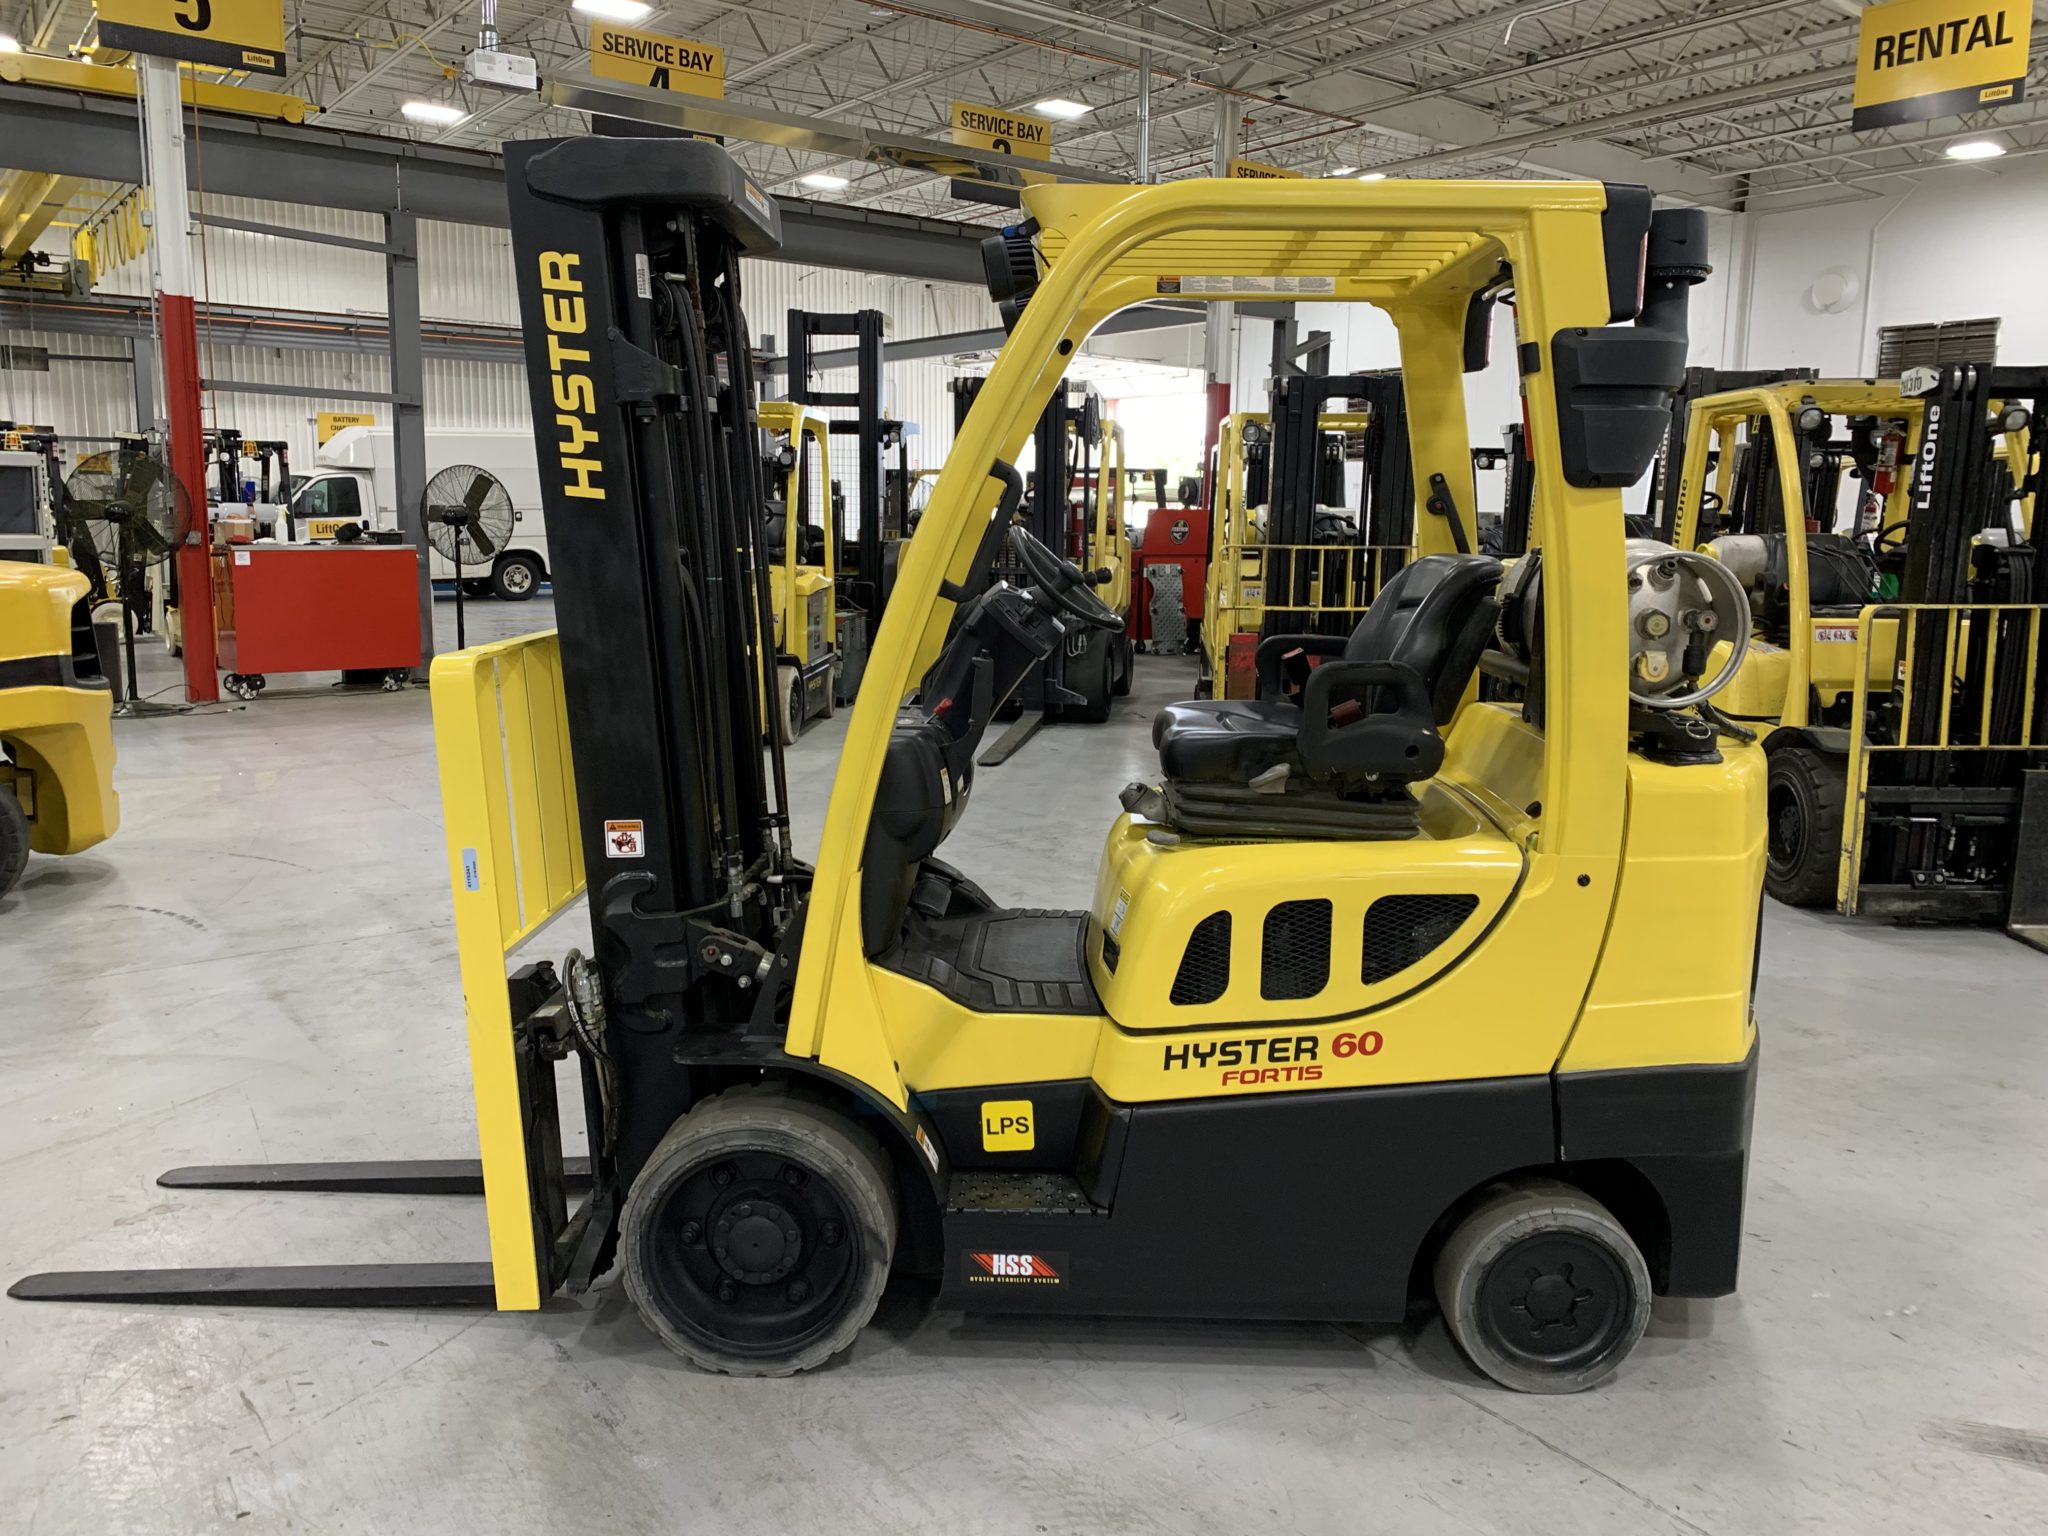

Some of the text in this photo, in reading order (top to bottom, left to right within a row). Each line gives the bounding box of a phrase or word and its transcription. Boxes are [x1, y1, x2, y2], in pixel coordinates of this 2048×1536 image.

[602, 32, 713, 72] SERVICE BAY
[1874, 11, 2014, 71] RENTAL
[247, 54, 271, 65] LiftOne
[1985, 88, 2008, 98] LiftOne
[961, 111, 1043, 142] SERVICE BAY
[539, 251, 606, 500] HYSTER
[1917, 405, 1940, 509] LiftOne
[316, 523, 339, 534] LiftO
[1163, 1031, 1384, 1071] HYSTER 60
[1221, 1065, 1323, 1086] FORTIS
[986, 1116, 1030, 1135] LPS
[992, 1254, 1033, 1276] HSS
